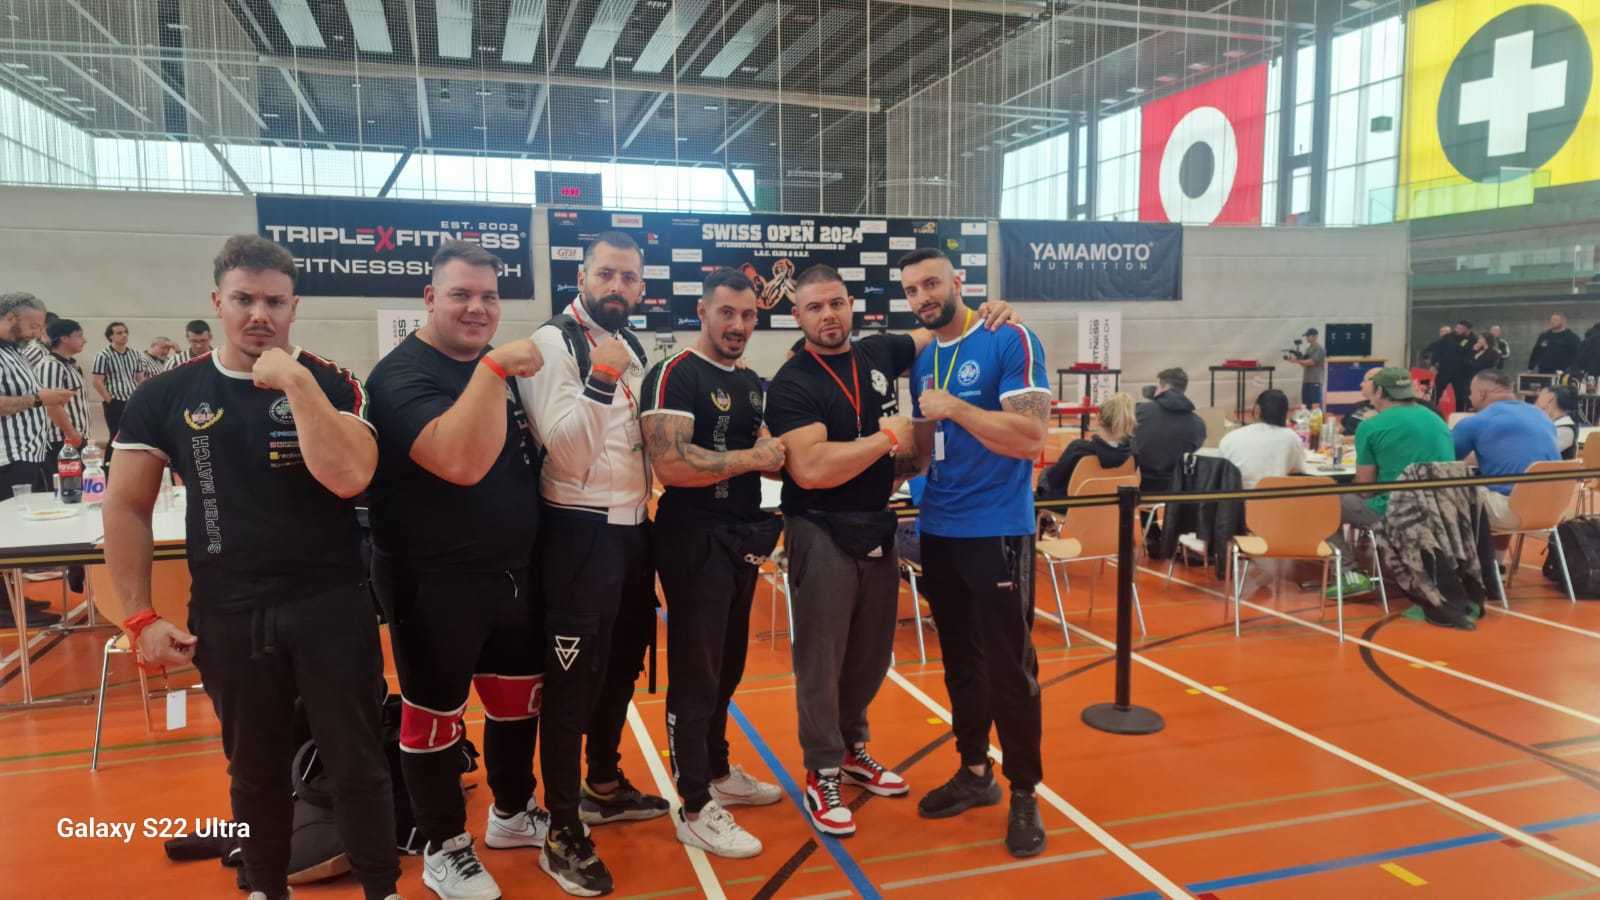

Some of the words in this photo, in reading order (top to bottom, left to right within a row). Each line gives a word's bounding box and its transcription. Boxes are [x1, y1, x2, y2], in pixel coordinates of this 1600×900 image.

[440, 220, 474, 230] EST.
[478, 222, 519, 232] 2003
[702, 223, 762, 241] SWISS
[767, 224, 814, 242] OPEN
[820, 226, 863, 244] 2024
[1030, 242, 1150, 261] YAMAMOTO
[1033, 262, 1148, 270] NUTRITION
[192, 434, 217, 494] MATCH
[204, 498, 222, 554] SUPER
